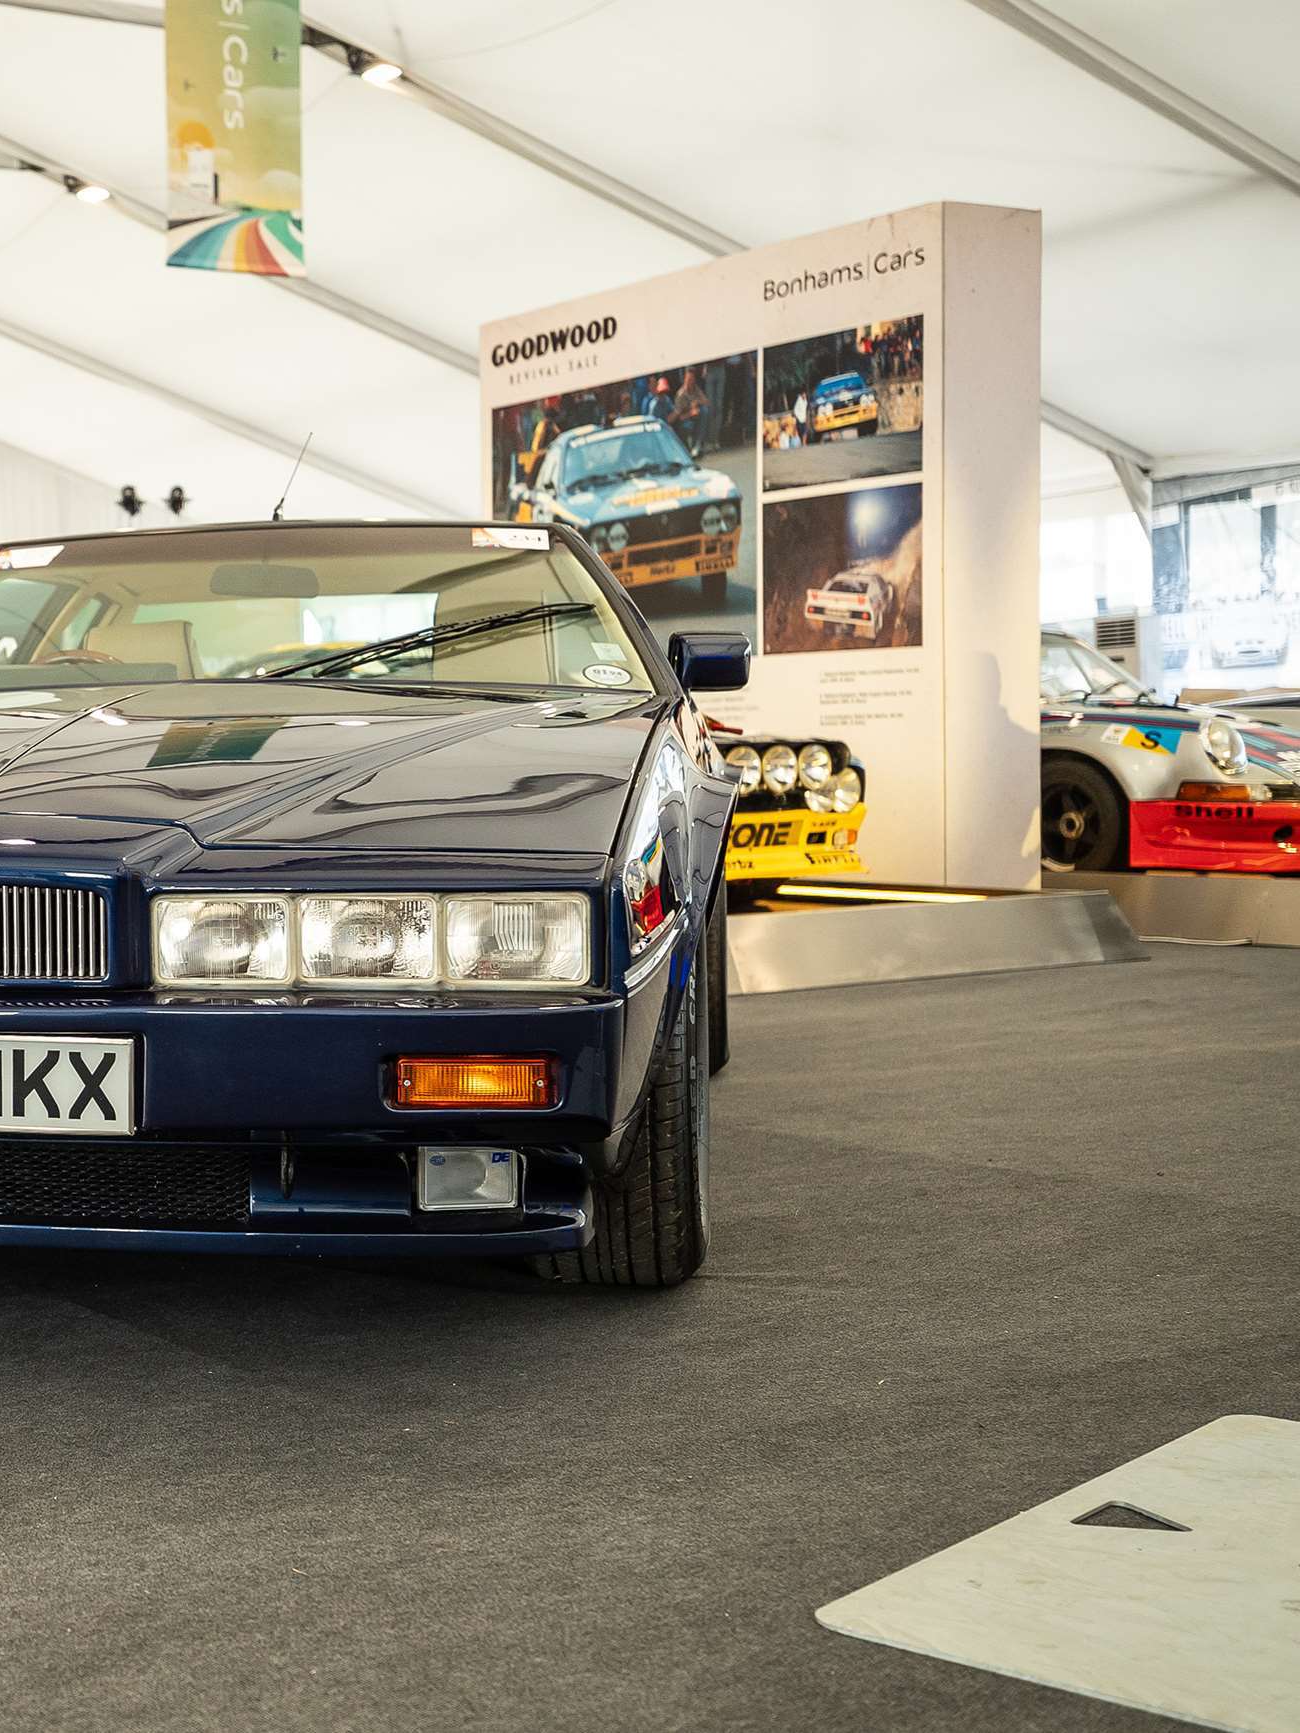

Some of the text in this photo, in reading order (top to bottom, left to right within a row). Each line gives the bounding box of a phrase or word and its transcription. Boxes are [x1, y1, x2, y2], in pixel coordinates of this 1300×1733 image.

[491, 316, 618, 367] GOODWOOD
[1139, 730, 1162, 749] S
[1174, 804, 1254, 818] Shell
[728, 821, 793, 848] ONE
[491, 1151, 511, 1164] DE
